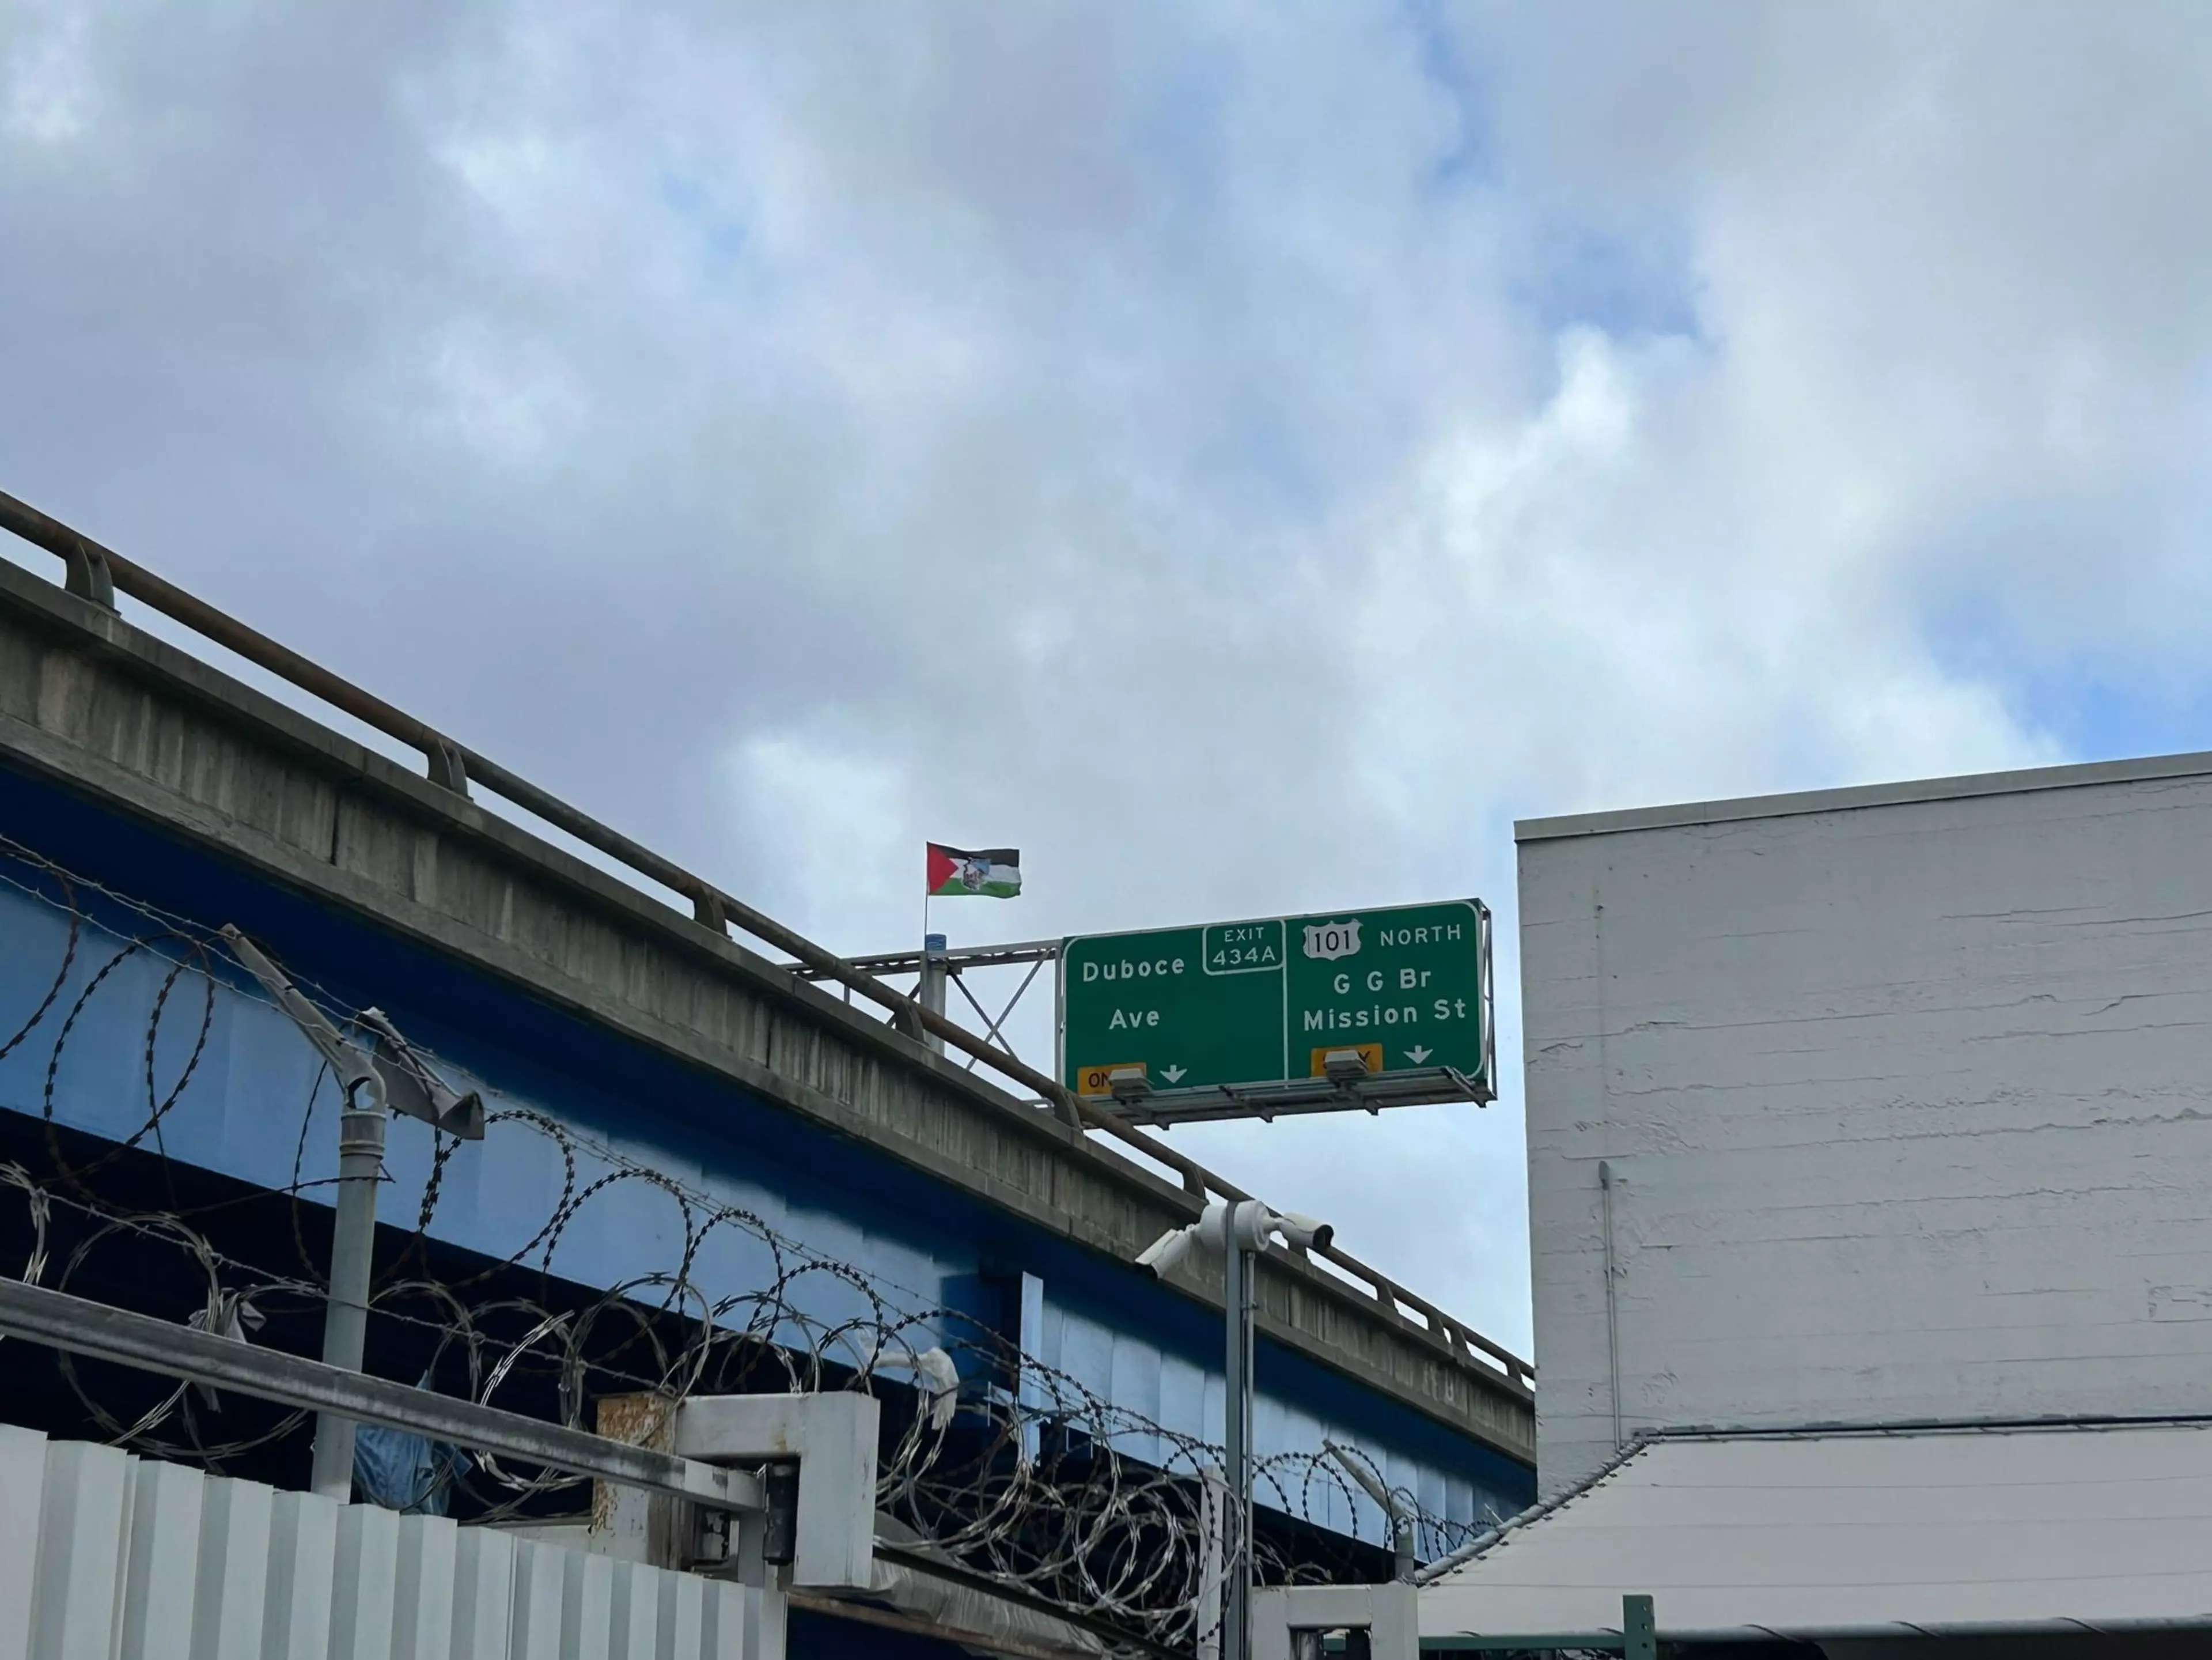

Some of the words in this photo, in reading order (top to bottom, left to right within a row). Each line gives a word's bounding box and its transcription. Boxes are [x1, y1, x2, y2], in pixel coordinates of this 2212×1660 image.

[1224, 927, 1264, 942] EXIT
[1314, 928, 1351, 952] 101
[1380, 924, 1461, 947] NORTH
[1213, 946, 1276, 966] 434A
[1083, 958, 1185, 982] Duboce
[1334, 974, 1350, 994] G
[1367, 971, 1383, 991] G
[1400, 968, 1431, 989] Br
[1109, 1008, 1160, 1030] Ave
[1304, 1004, 1417, 1031] Mission
[1434, 999, 1466, 1020] St
